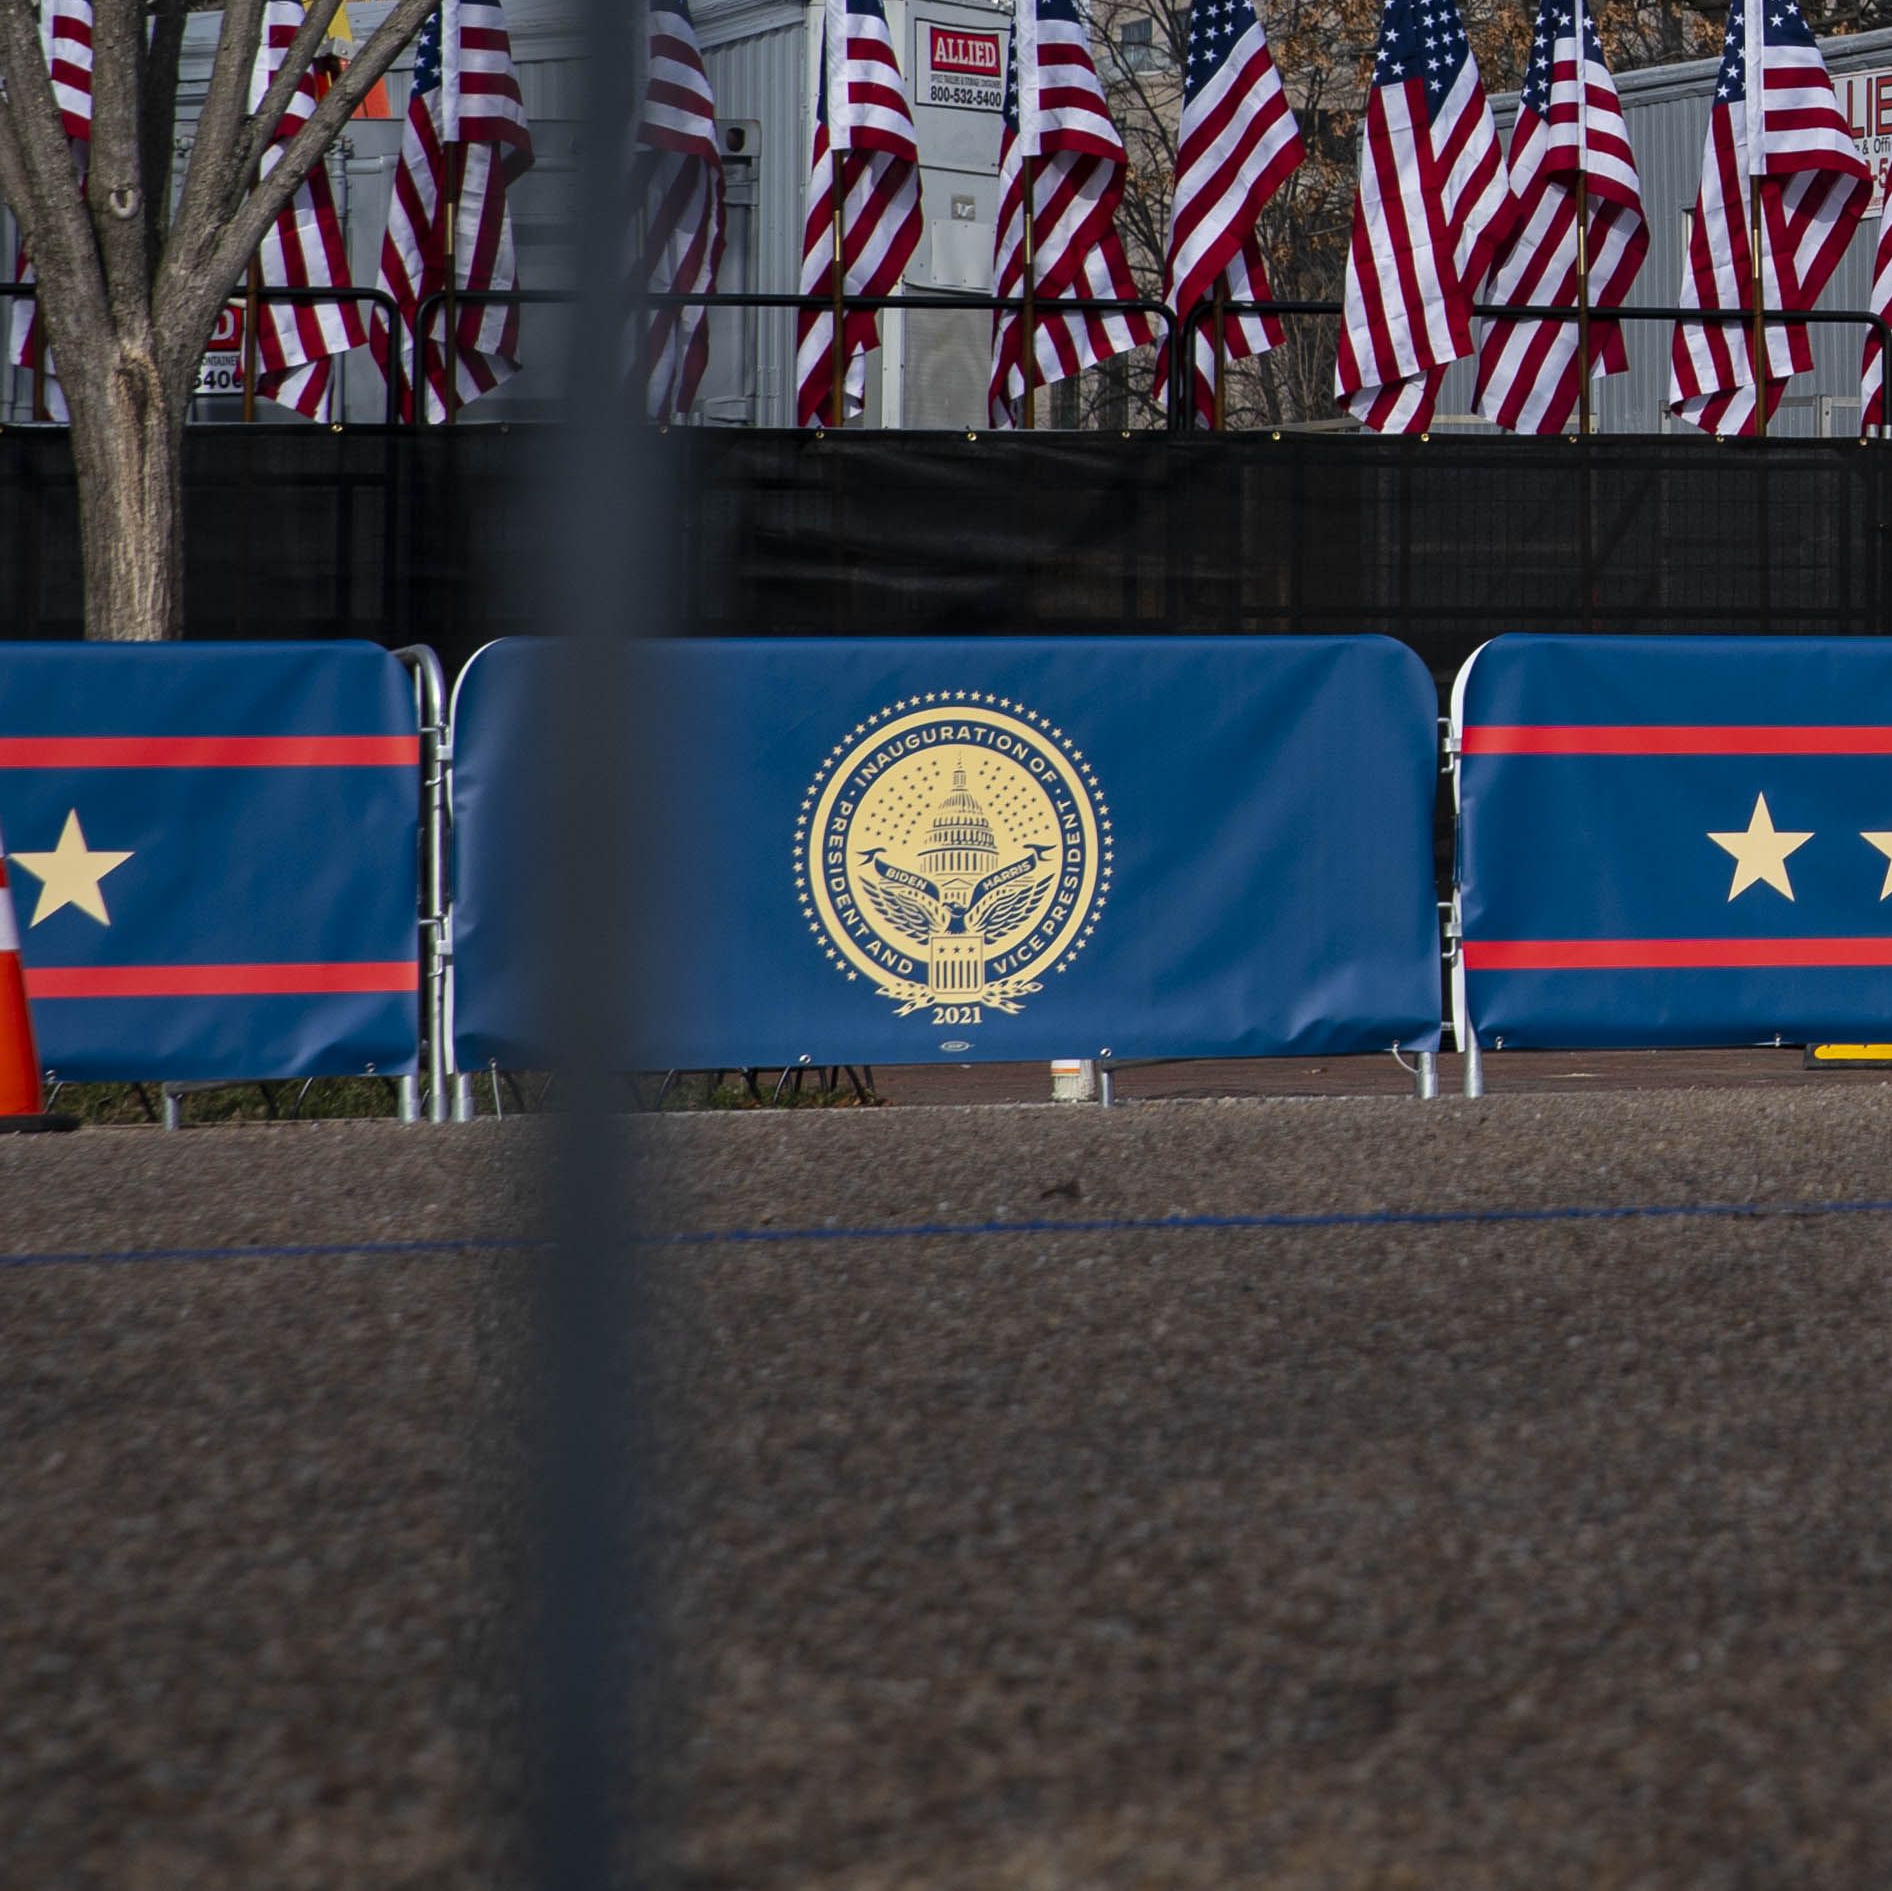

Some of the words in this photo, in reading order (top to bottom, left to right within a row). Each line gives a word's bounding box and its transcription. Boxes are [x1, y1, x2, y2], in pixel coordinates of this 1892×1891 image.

[934, 36, 997, 68] ALLIED
[930, 85, 1002, 108] 800-532-5400
[1860, 139, 1870, 156] &
[1873, 136, 1891, 154] Offi
[854, 726, 1029, 787] INAUGURATION
[1029, 757, 1058, 785] OF
[828, 800, 870, 937] PRESIDENT
[865, 939, 914, 975] AND
[993, 934, 1045, 975] VICE
[1042, 800, 1080, 935] PRESIDENT
[885, 866, 928, 891] BIDEN
[982, 860, 1032, 891] HARRIS
[931, 1007, 983, 1025] 2021
